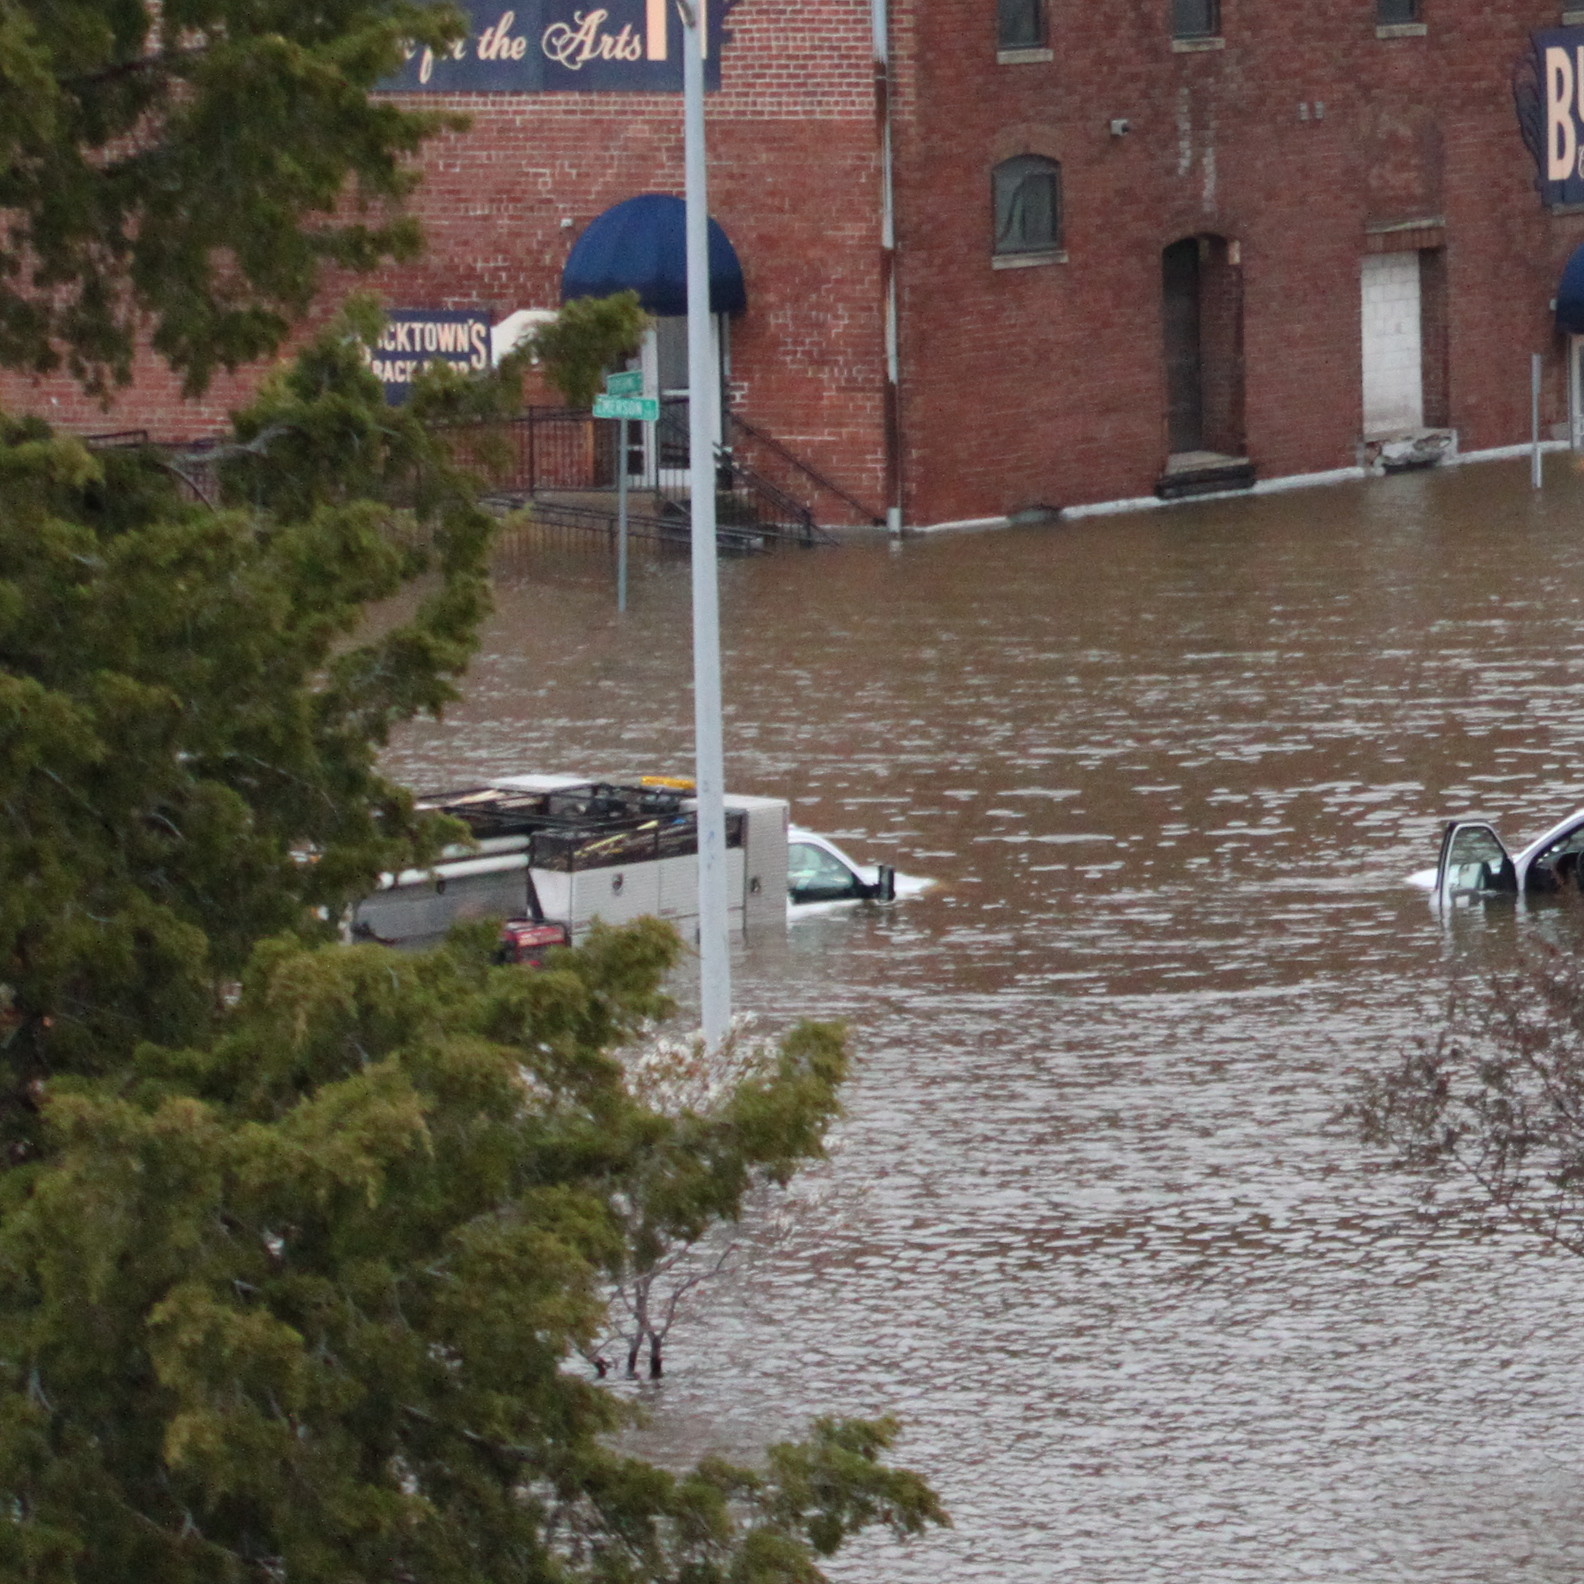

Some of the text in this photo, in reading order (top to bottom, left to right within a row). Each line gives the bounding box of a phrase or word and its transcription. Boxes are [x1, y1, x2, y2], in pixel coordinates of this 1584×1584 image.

[477, 10, 527, 61] the
[541, 8, 644, 69] Arts
[359, 318, 487, 370] CKTOWN'S
